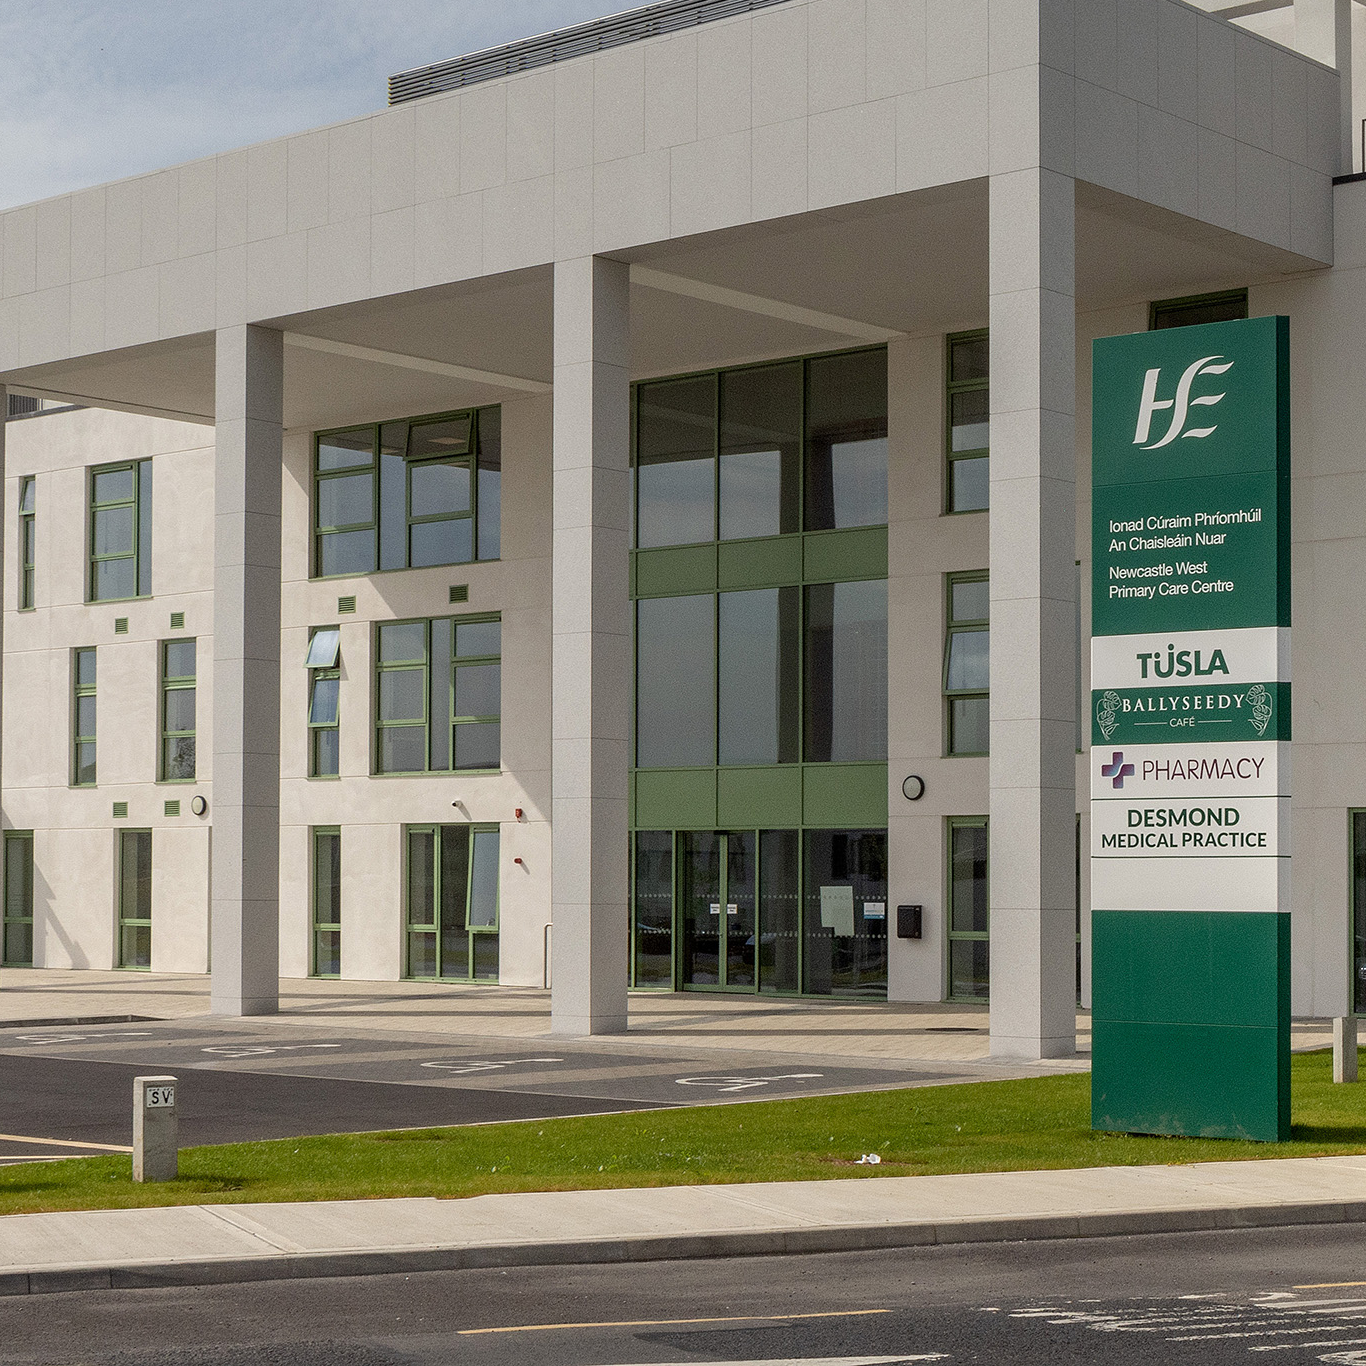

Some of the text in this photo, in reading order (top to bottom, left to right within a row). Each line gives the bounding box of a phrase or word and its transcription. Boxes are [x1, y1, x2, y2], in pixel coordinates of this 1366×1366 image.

[1110, 509, 1261, 532] Ionad Cúraim Phríomhúil
[1109, 533, 1226, 552] An Chaisleáin Nuar
[1110, 561, 1207, 579] Newcastle West
[1110, 580, 1233, 599] Primary Care Centre
[1123, 694, 1244, 712] BALLYSEEDY
[1170, 716, 1195, 727] CAFÉ
[1143, 758, 1264, 780] PHARMACY
[1128, 808, 1239, 827] DESMOND
[1102, 833, 1266, 848] MEDICAL PRACTICE
[152, 1091, 170, 1104] SV
